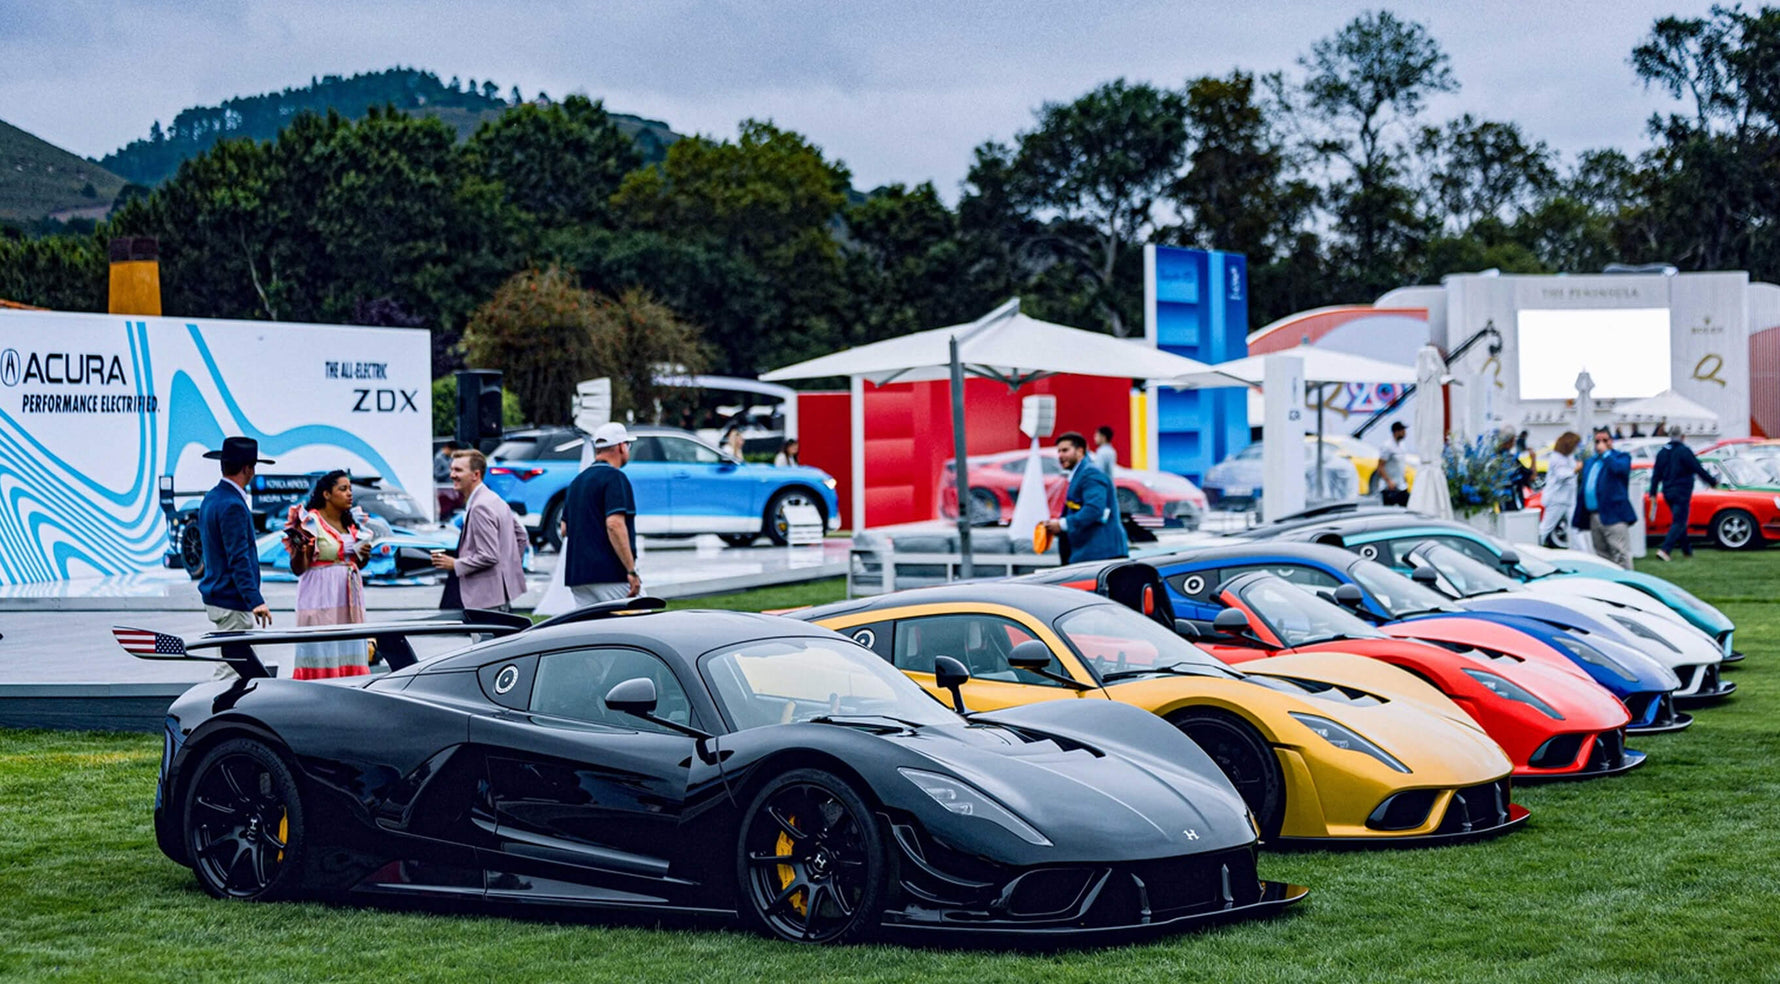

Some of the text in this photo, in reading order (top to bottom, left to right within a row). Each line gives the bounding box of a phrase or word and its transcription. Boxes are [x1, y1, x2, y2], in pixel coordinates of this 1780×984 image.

[22, 351, 127, 385] ACURA
[325, 361, 339, 379] THE
[1689, 354, 1726, 389] Q
[22, 394, 161, 414] PERFORMANCE ELECTRIFIED.
[351, 388, 419, 413] ZDX
